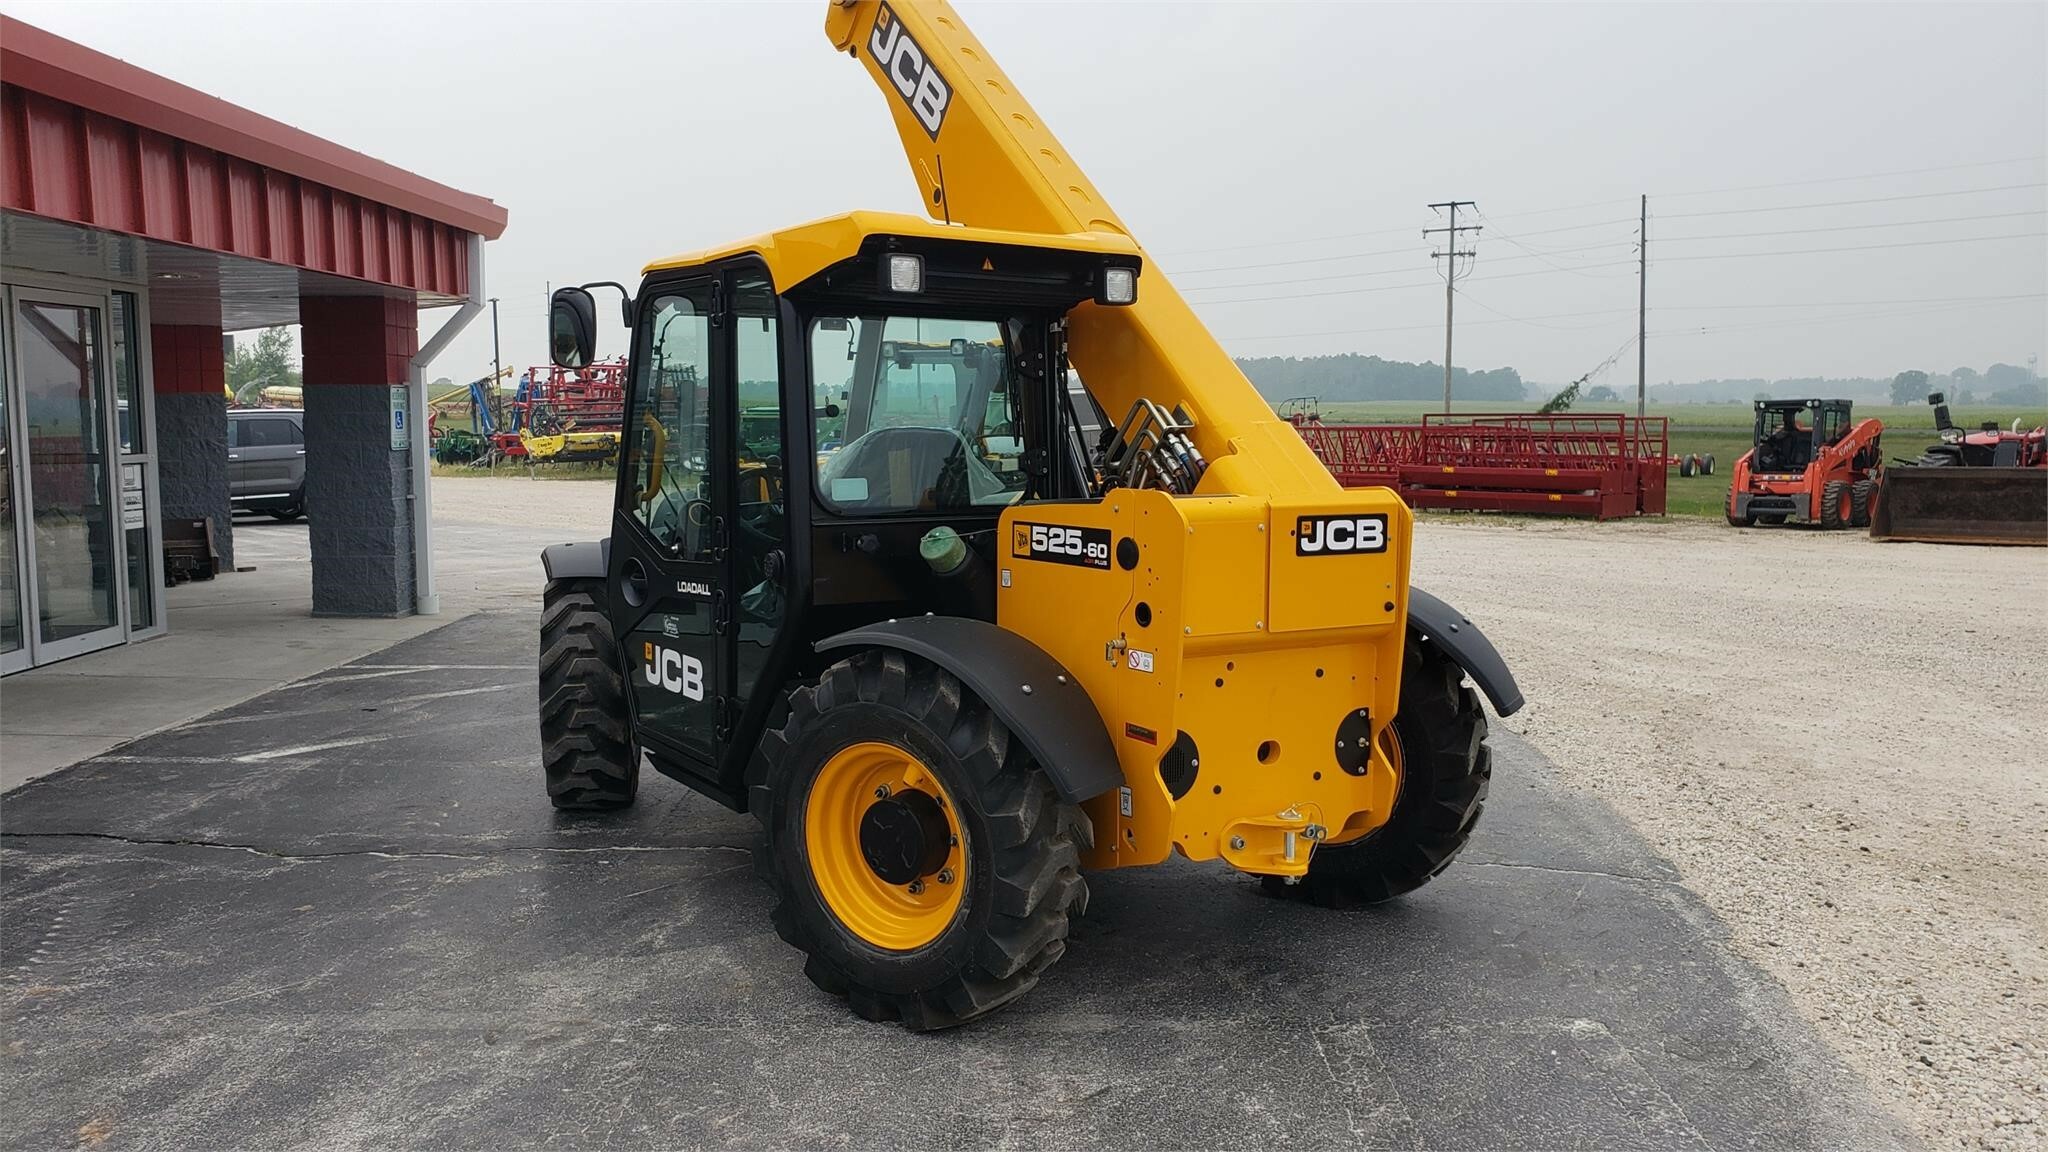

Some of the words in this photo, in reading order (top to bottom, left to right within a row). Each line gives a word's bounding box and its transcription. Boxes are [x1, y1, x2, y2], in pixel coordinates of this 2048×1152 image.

[871, 20, 948, 132] JCB
[1300, 519, 1384, 552] JCB
[677, 581, 711, 596] LOADALL
[645, 645, 704, 702] JCB
